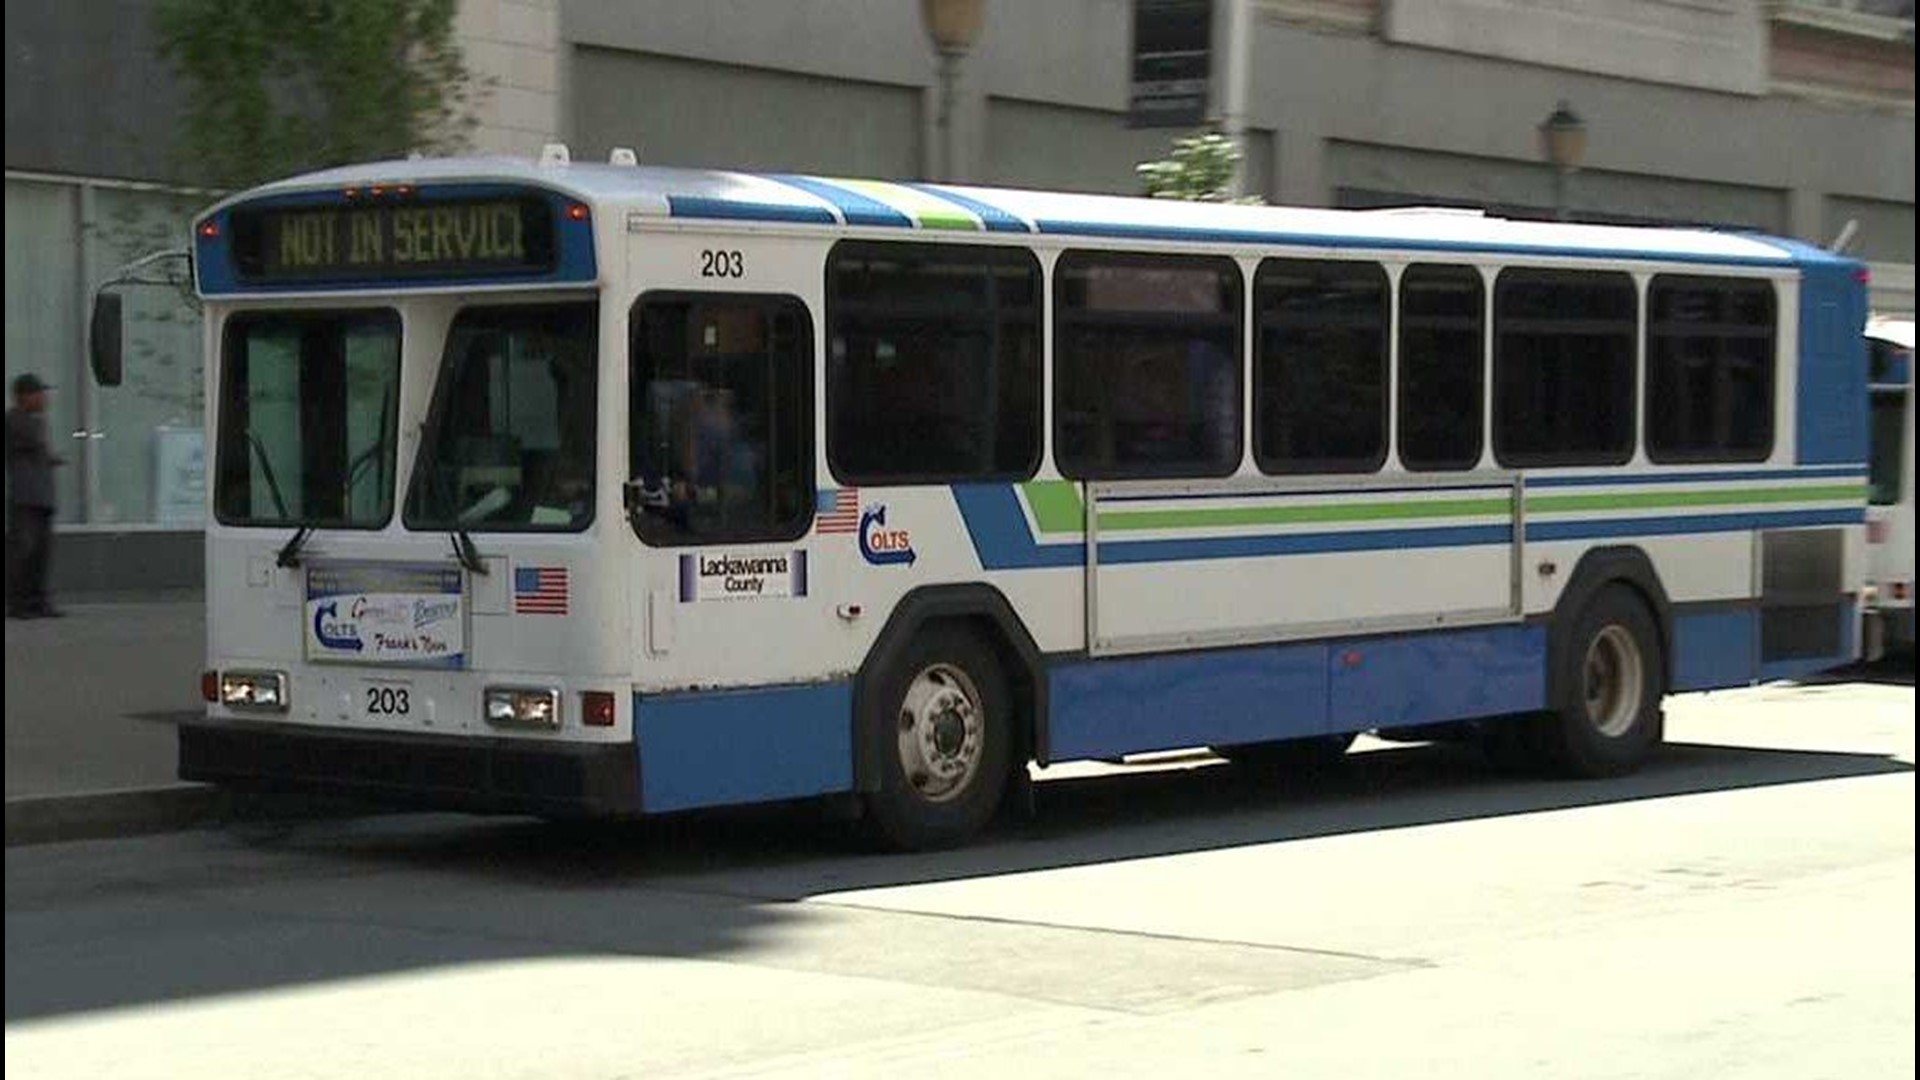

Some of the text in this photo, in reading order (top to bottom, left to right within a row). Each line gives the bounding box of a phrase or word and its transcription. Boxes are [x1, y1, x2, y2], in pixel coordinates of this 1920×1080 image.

[281, 212, 338, 266] NOT
[351, 210, 383, 264] IN
[701, 249, 744, 278] 203
[700, 554, 788, 577] Lackawanna
[724, 576, 765, 594] County
[366, 687, 411, 715] 203
